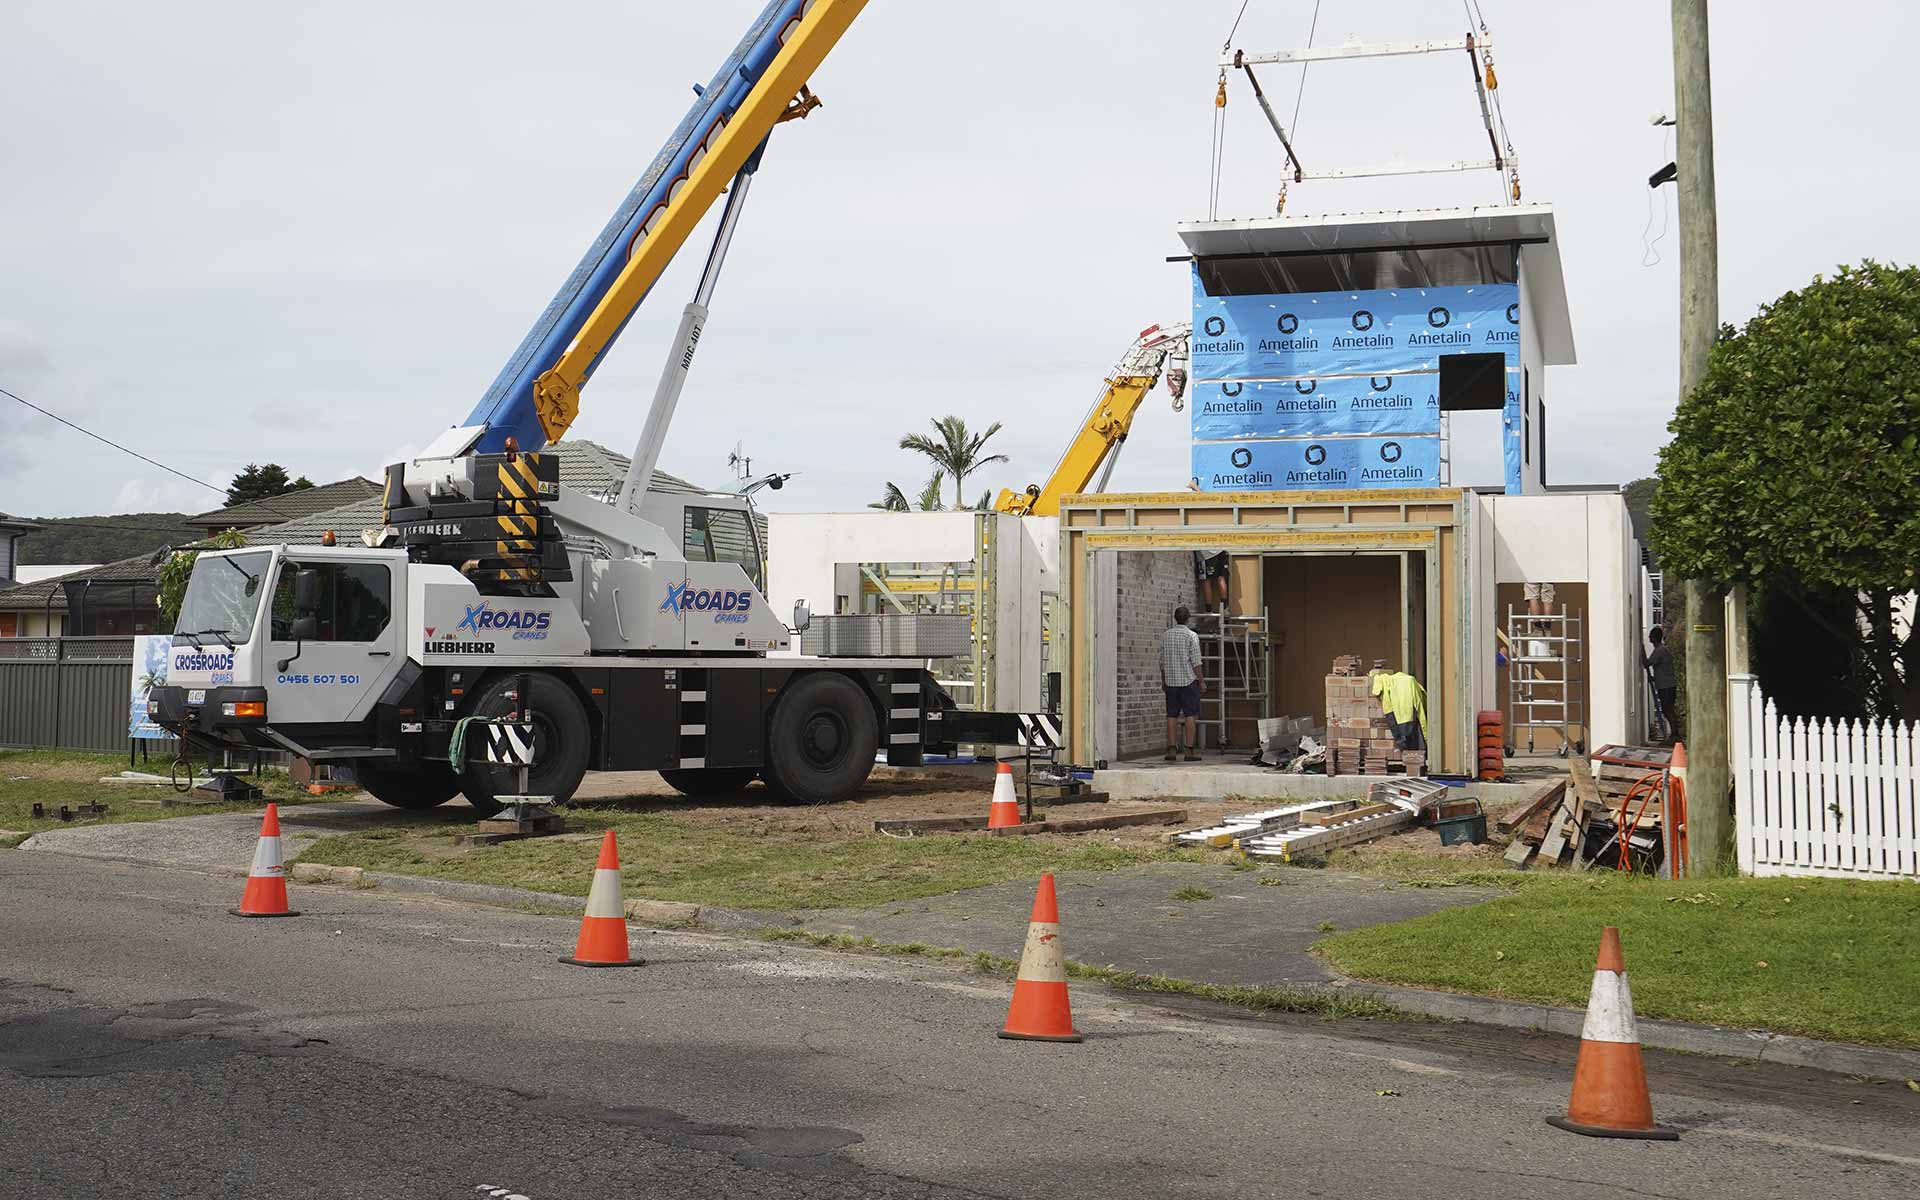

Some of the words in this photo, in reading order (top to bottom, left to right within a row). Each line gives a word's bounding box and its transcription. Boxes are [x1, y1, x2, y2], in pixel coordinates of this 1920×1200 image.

[681, 345, 695, 370] MRC
[691, 324, 702, 345] 40T
[1258, 336, 1319, 351] Ametalin
[1333, 334, 1394, 348] Ametalin
[1408, 331, 1471, 345] Ametalin
[1203, 399, 1262, 412] Ametalin
[1276, 397, 1337, 410] Ametalin
[1351, 395, 1412, 409] Ametalin
[1213, 472, 1272, 485] Ametalin
[1286, 470, 1347, 483] Ametalin
[1361, 465, 1423, 479] Ametalin
[660, 581, 752, 617] XROADS
[457, 601, 550, 635] XROADS
[714, 613, 749, 624] CRANES
[424, 641, 495, 653] LIEBHERR
[175, 653, 234, 671] CROSSROADS
[277, 675, 309, 684] 0456
[313, 675, 335, 684] 607
[340, 675, 359, 684] 501
